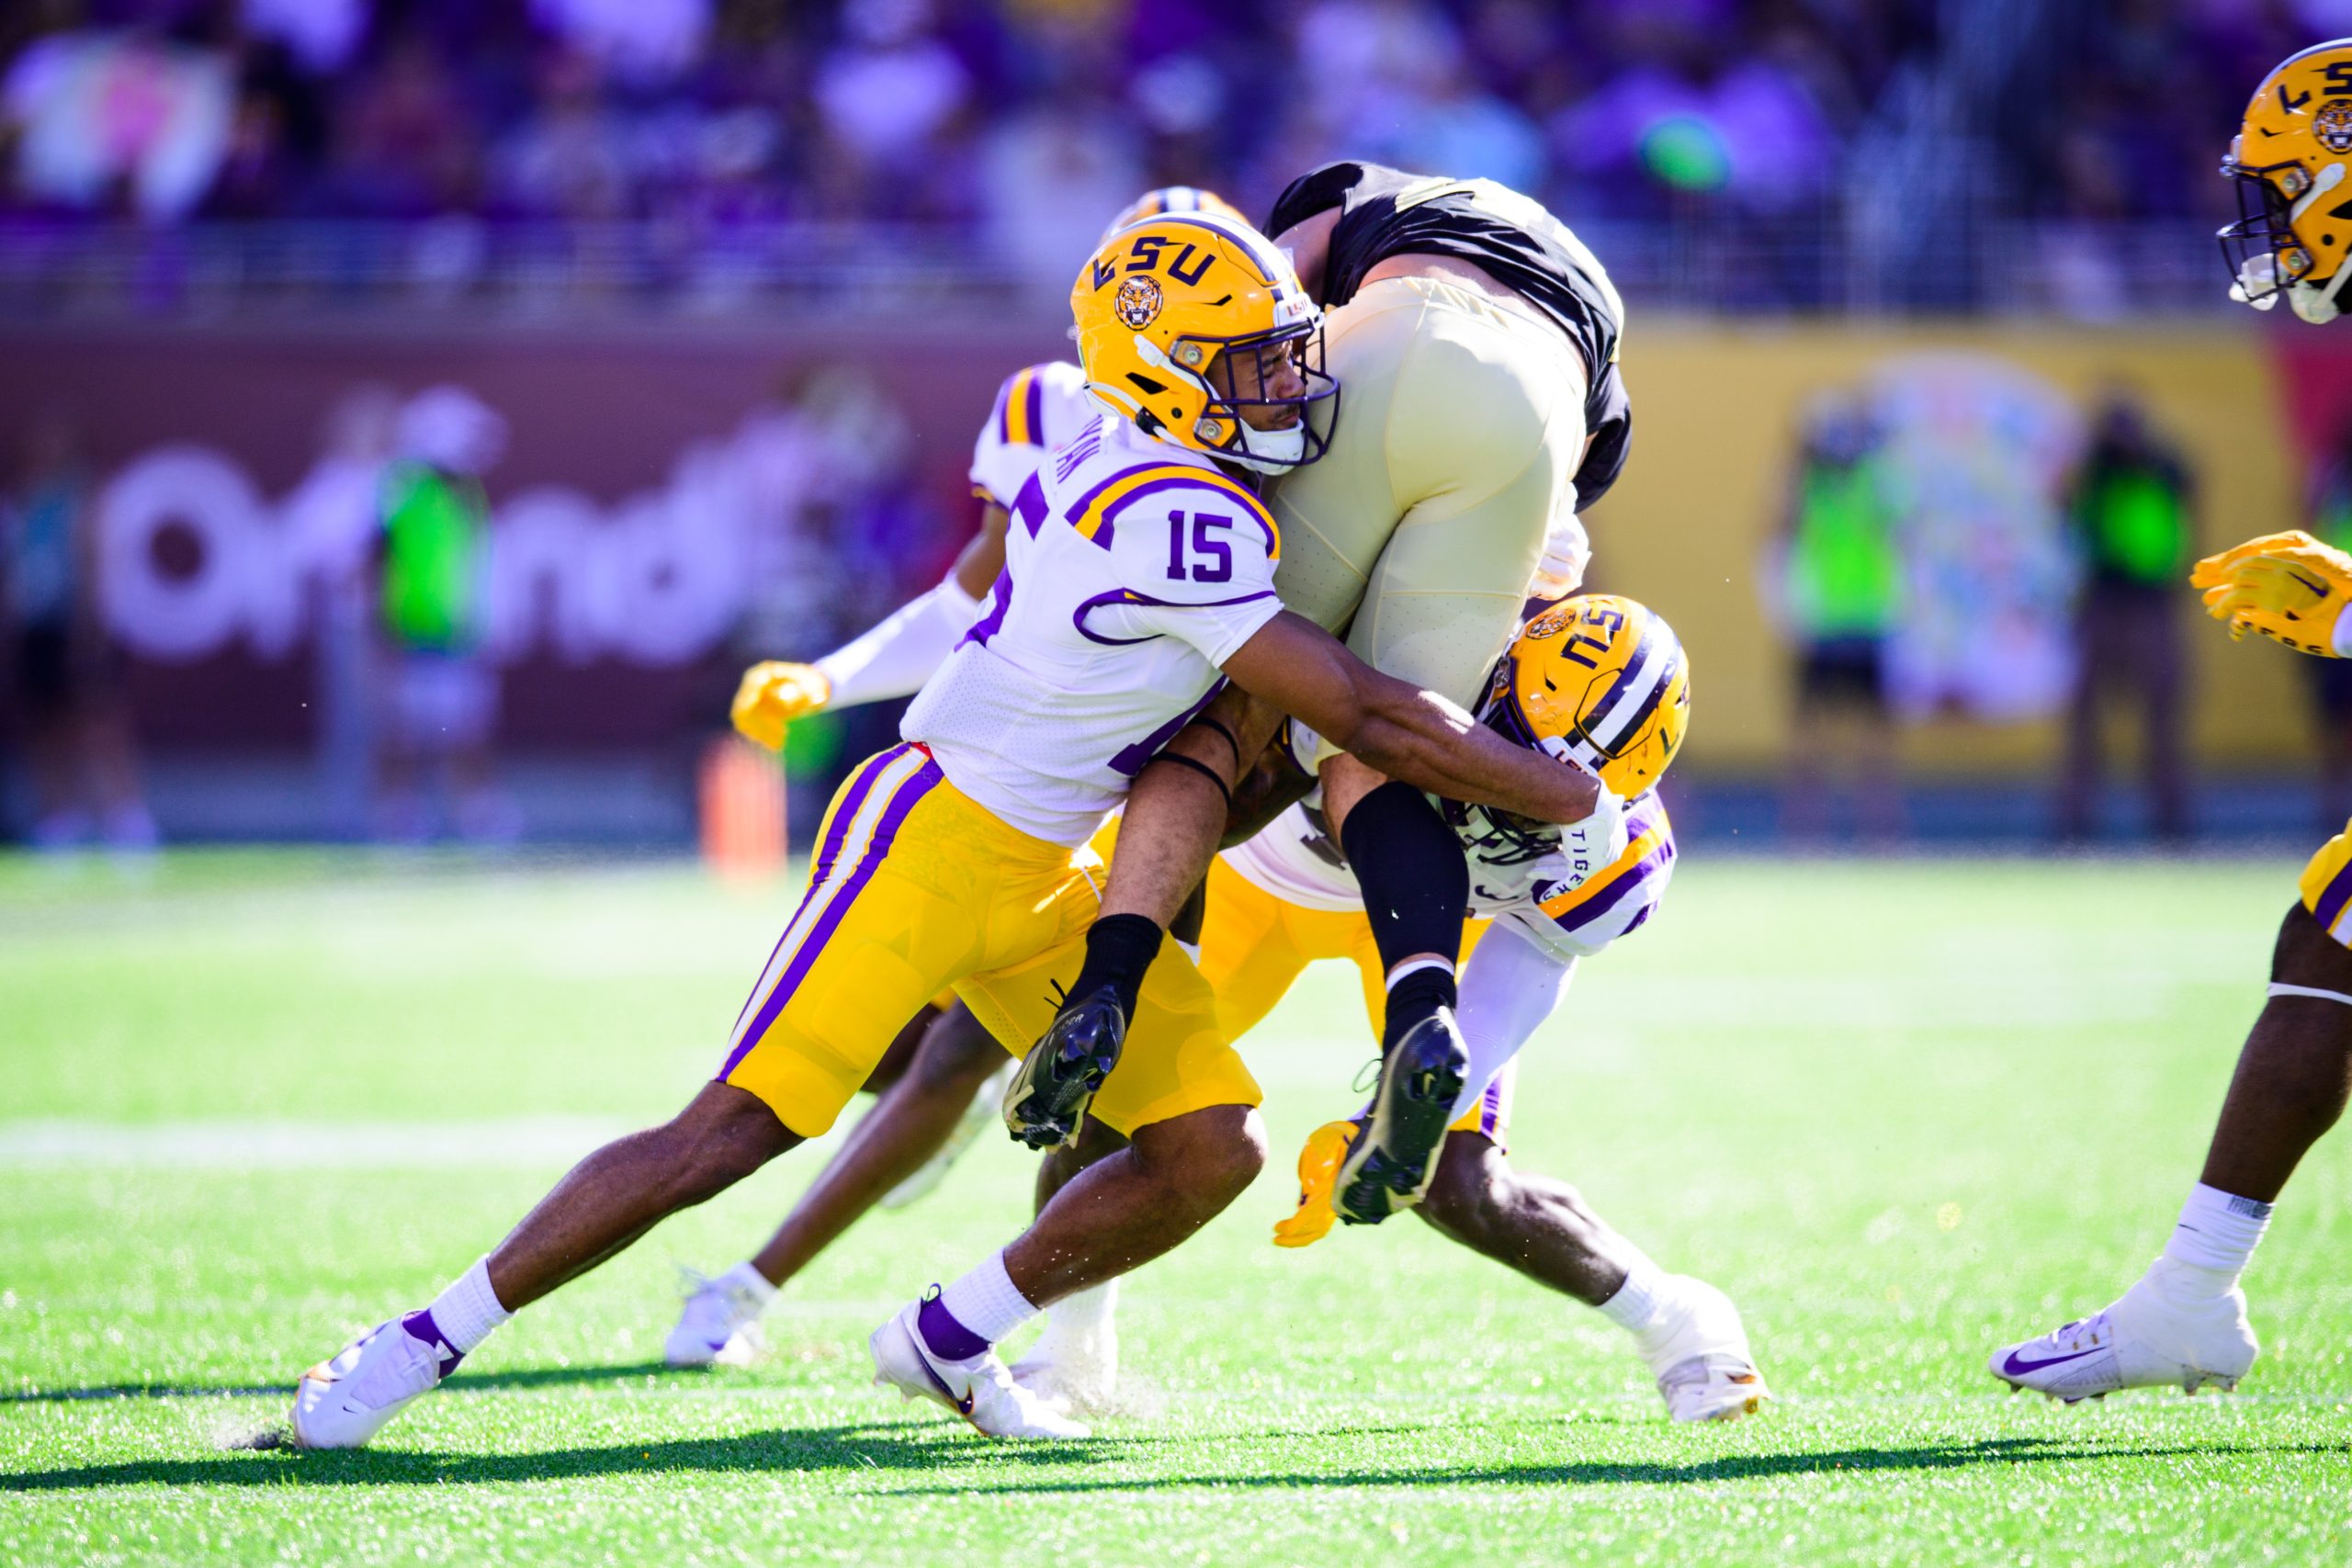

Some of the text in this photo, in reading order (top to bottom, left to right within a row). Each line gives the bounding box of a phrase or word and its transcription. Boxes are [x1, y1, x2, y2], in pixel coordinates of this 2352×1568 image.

[2278, 62, 2352, 115] LS
[1092, 236, 1216, 292] LSU
[1056, 413, 1104, 485] YAN
[1167, 510, 1233, 582] 15
[1560, 606, 1624, 671] SU
